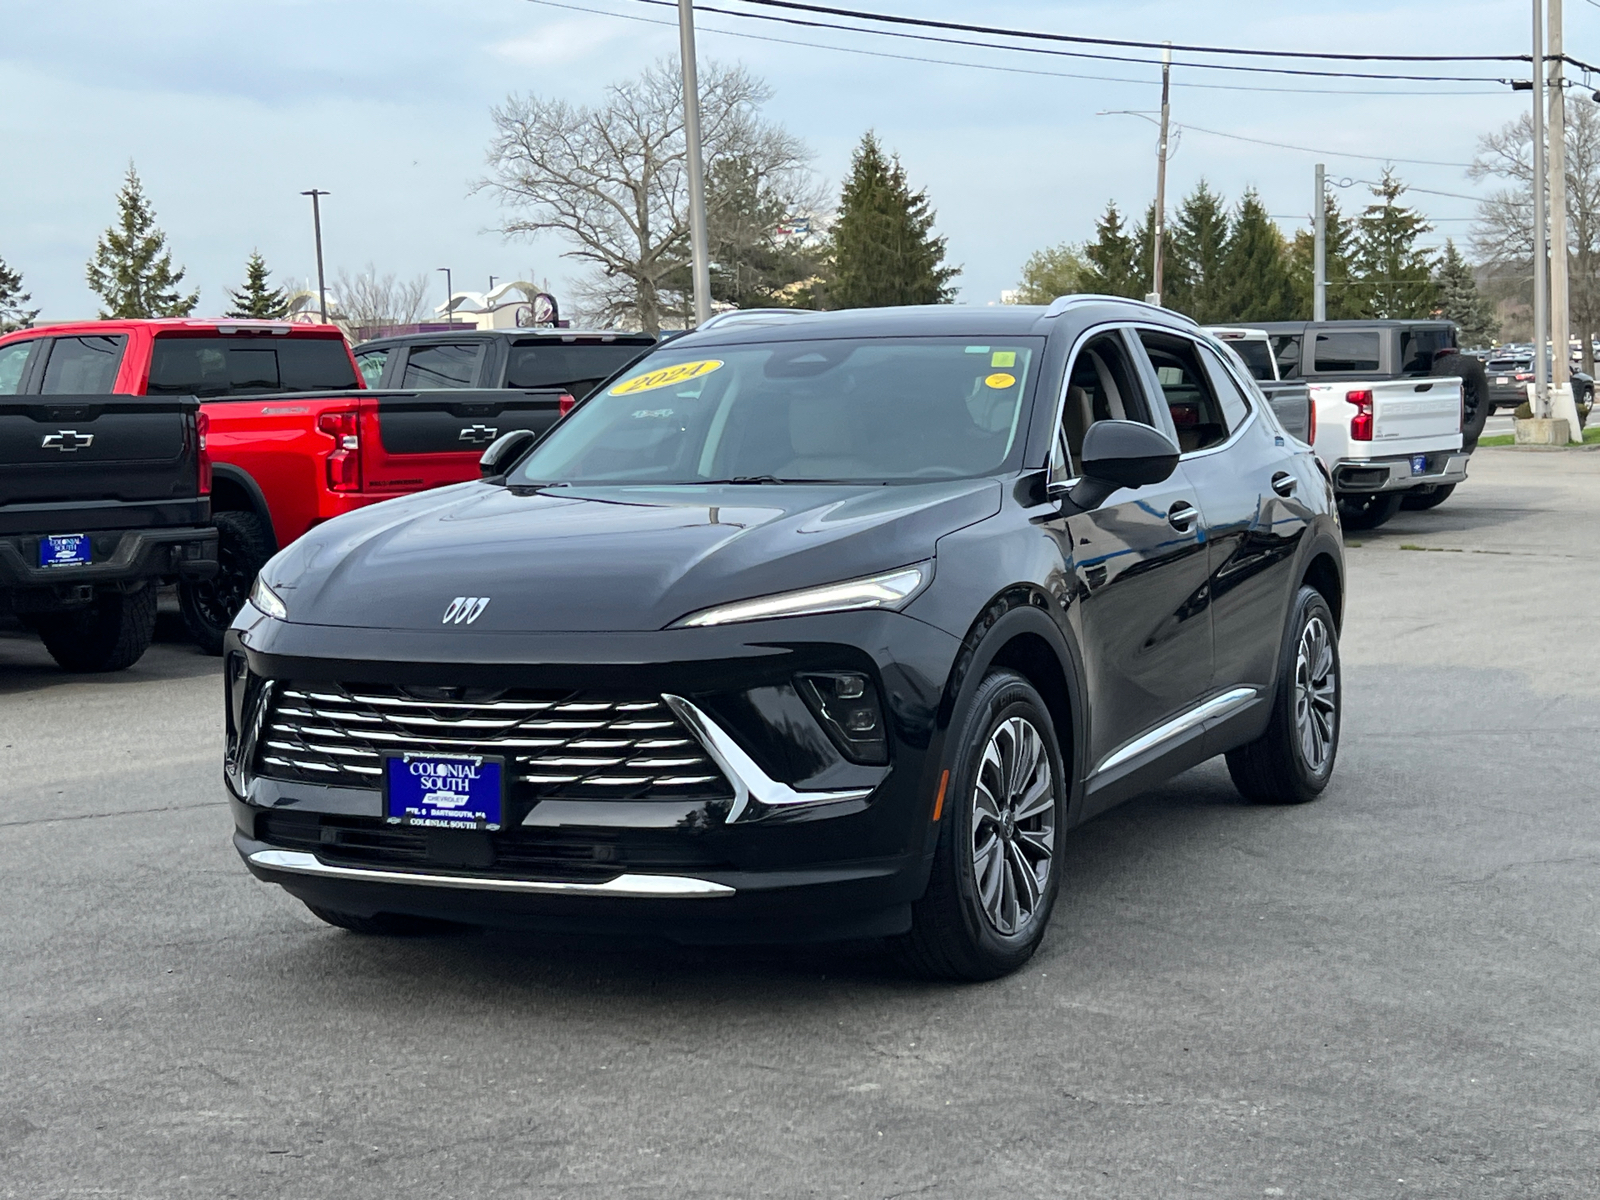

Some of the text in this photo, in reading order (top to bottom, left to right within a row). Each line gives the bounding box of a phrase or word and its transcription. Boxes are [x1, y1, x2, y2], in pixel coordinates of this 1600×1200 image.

[625, 362, 706, 393] 2024
[409, 762, 481, 779] COLONIAL
[420, 776, 470, 792] SOUTH
[427, 795, 465, 804] CHEVROLET
[410, 818, 477, 830] COLONIAL SOUTH
